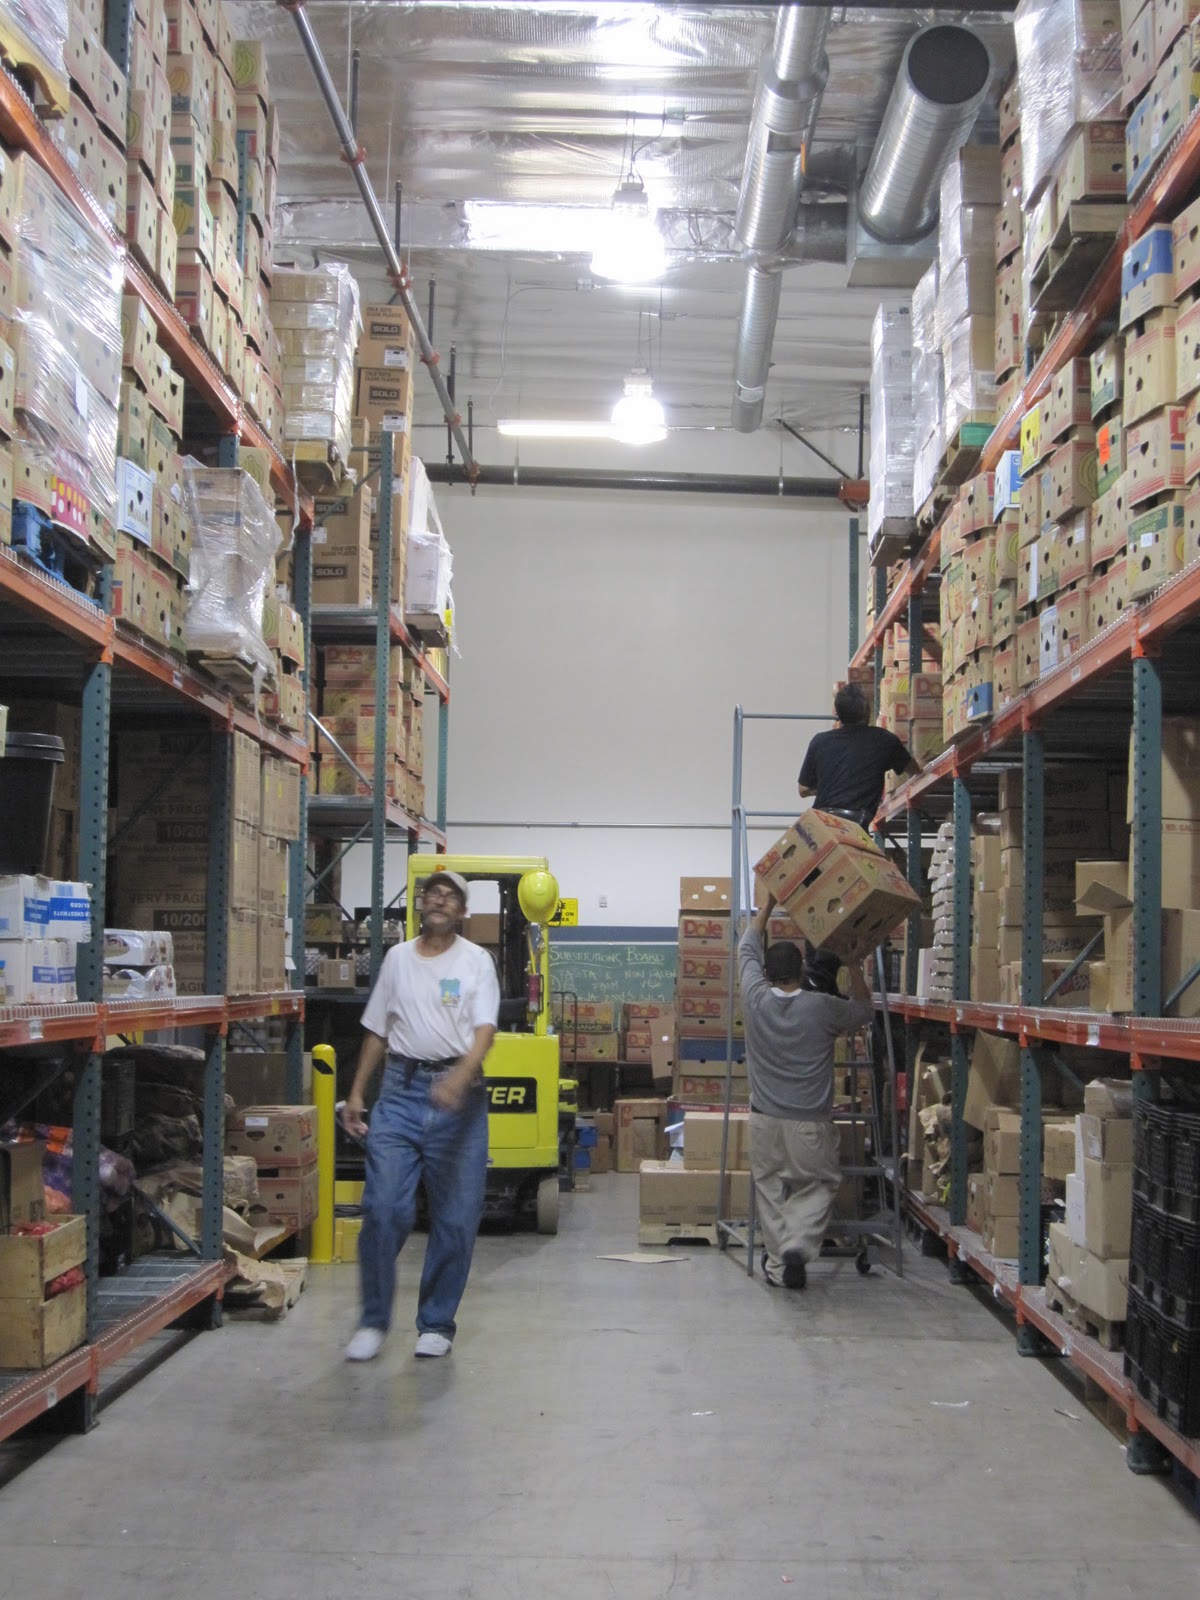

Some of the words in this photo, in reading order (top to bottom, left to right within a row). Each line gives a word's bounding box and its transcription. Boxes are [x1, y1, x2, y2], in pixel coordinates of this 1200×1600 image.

[372, 325, 399, 333] SOLO
[371, 390, 398, 398] SOLO
[315, 567, 344, 576] SOLO
[684, 920, 723, 935] Dole
[624, 945, 665, 962] BOARD
[683, 960, 722, 976] Dole
[570, 1004, 595, 1016] Dole
[630, 1004, 660, 1017] Dole
[682, 999, 721, 1014] Dole
[683, 1079, 721, 1094] Dole
